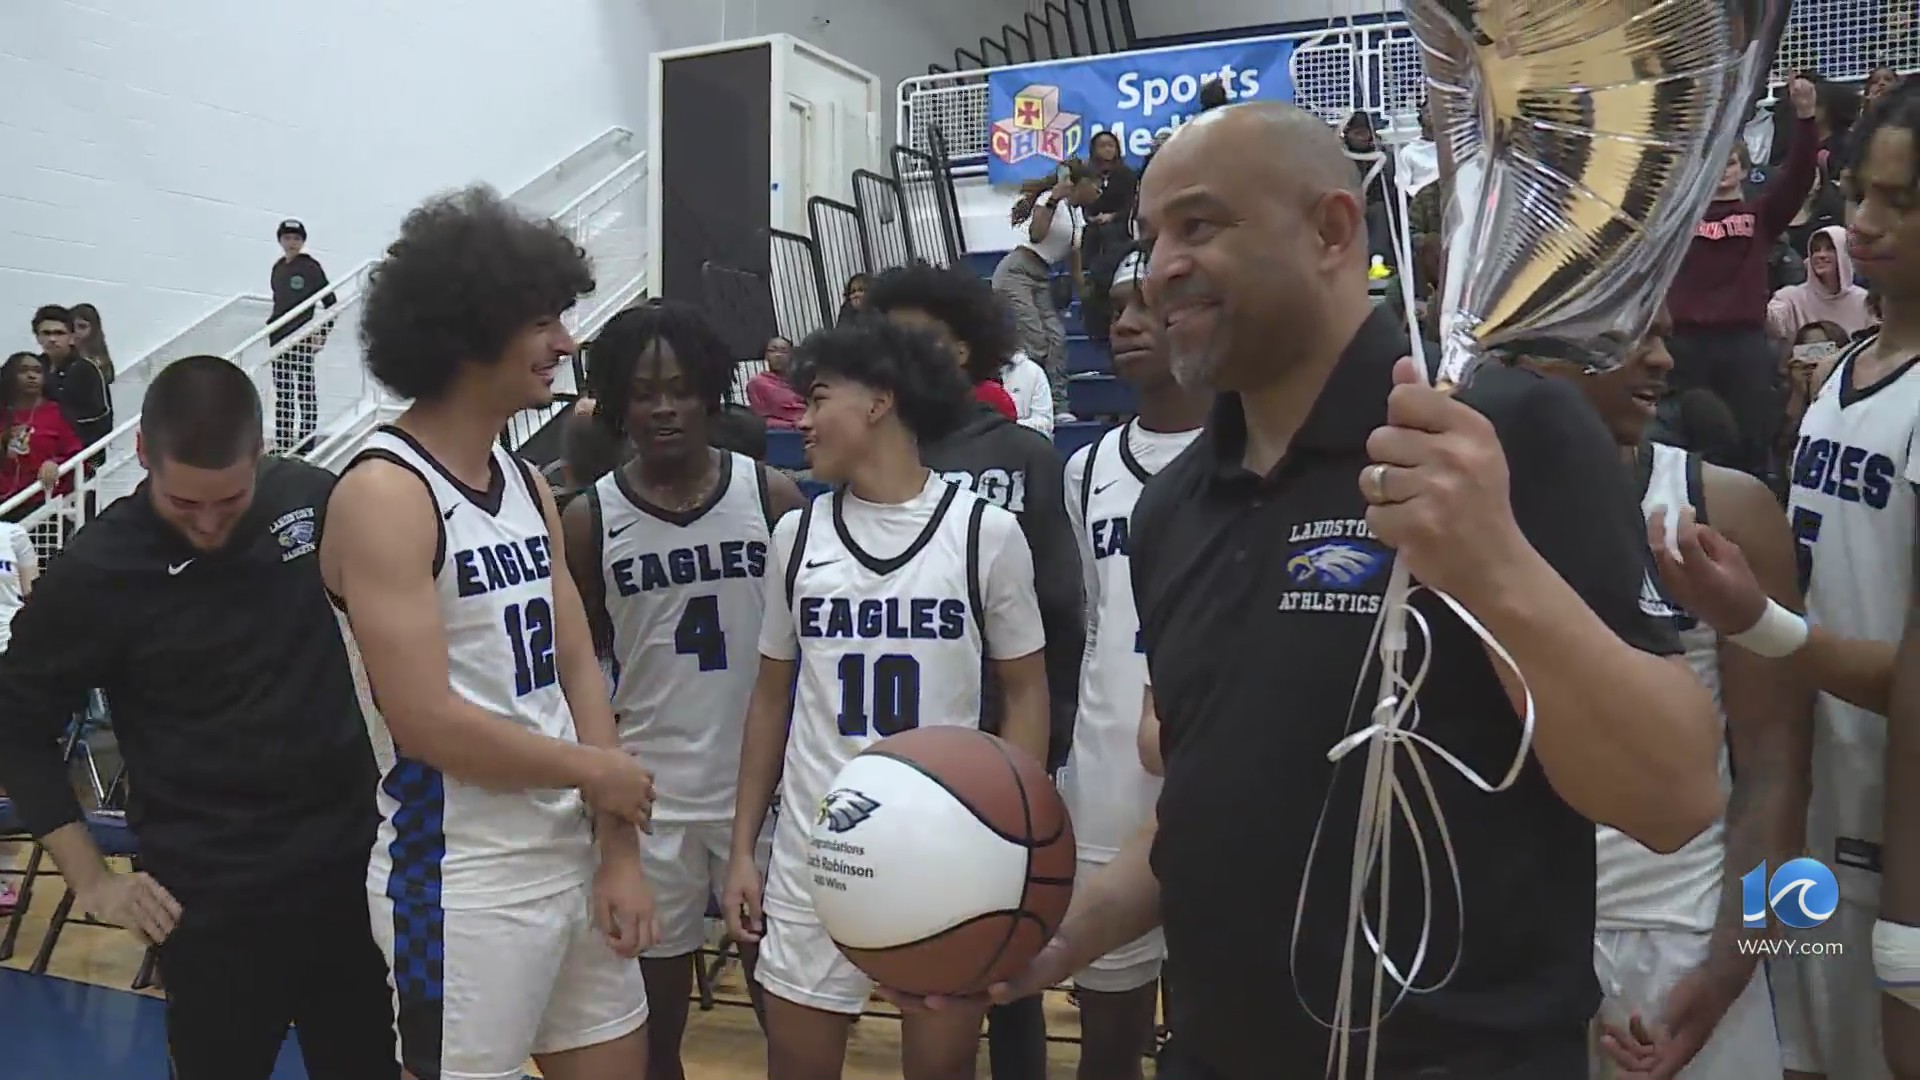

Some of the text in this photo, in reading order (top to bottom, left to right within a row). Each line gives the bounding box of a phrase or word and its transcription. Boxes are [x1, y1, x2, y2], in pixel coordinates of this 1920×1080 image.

[1288, 519, 1378, 541] LANDSTO
[611, 540, 767, 597] EAGLES
[799, 597, 966, 640] EAGLES
[1279, 591, 1381, 613] ATHLETICS
[504, 597, 555, 697] 12
[674, 595, 727, 671] 4
[837, 653, 920, 737] 10
[822, 857, 874, 878] Robinson
[826, 876, 847, 891] Wins
